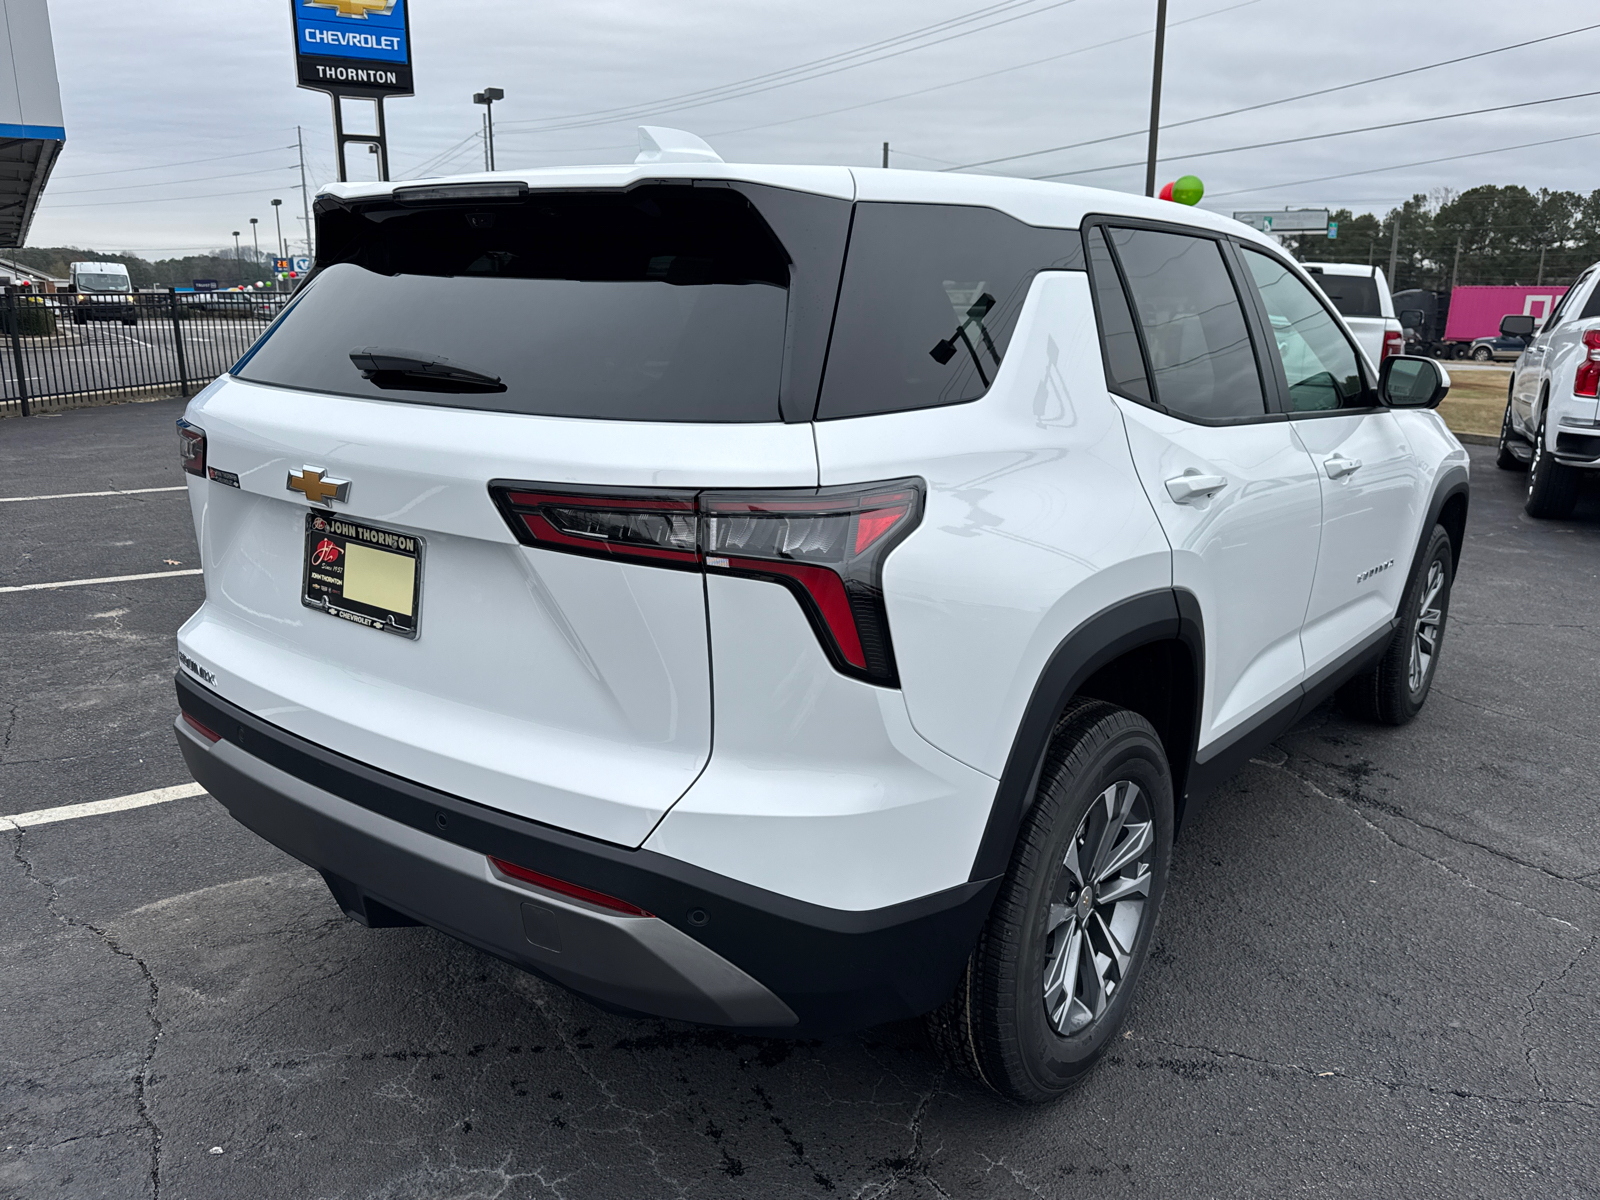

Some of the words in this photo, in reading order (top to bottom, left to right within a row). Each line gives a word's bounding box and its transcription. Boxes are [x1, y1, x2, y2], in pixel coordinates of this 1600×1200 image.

[304, 28, 400, 51] CHEVROLET
[316, 65, 397, 84] THORNTON
[331, 521, 356, 537] JOHN
[339, 611, 371, 625] CHEVROLET
